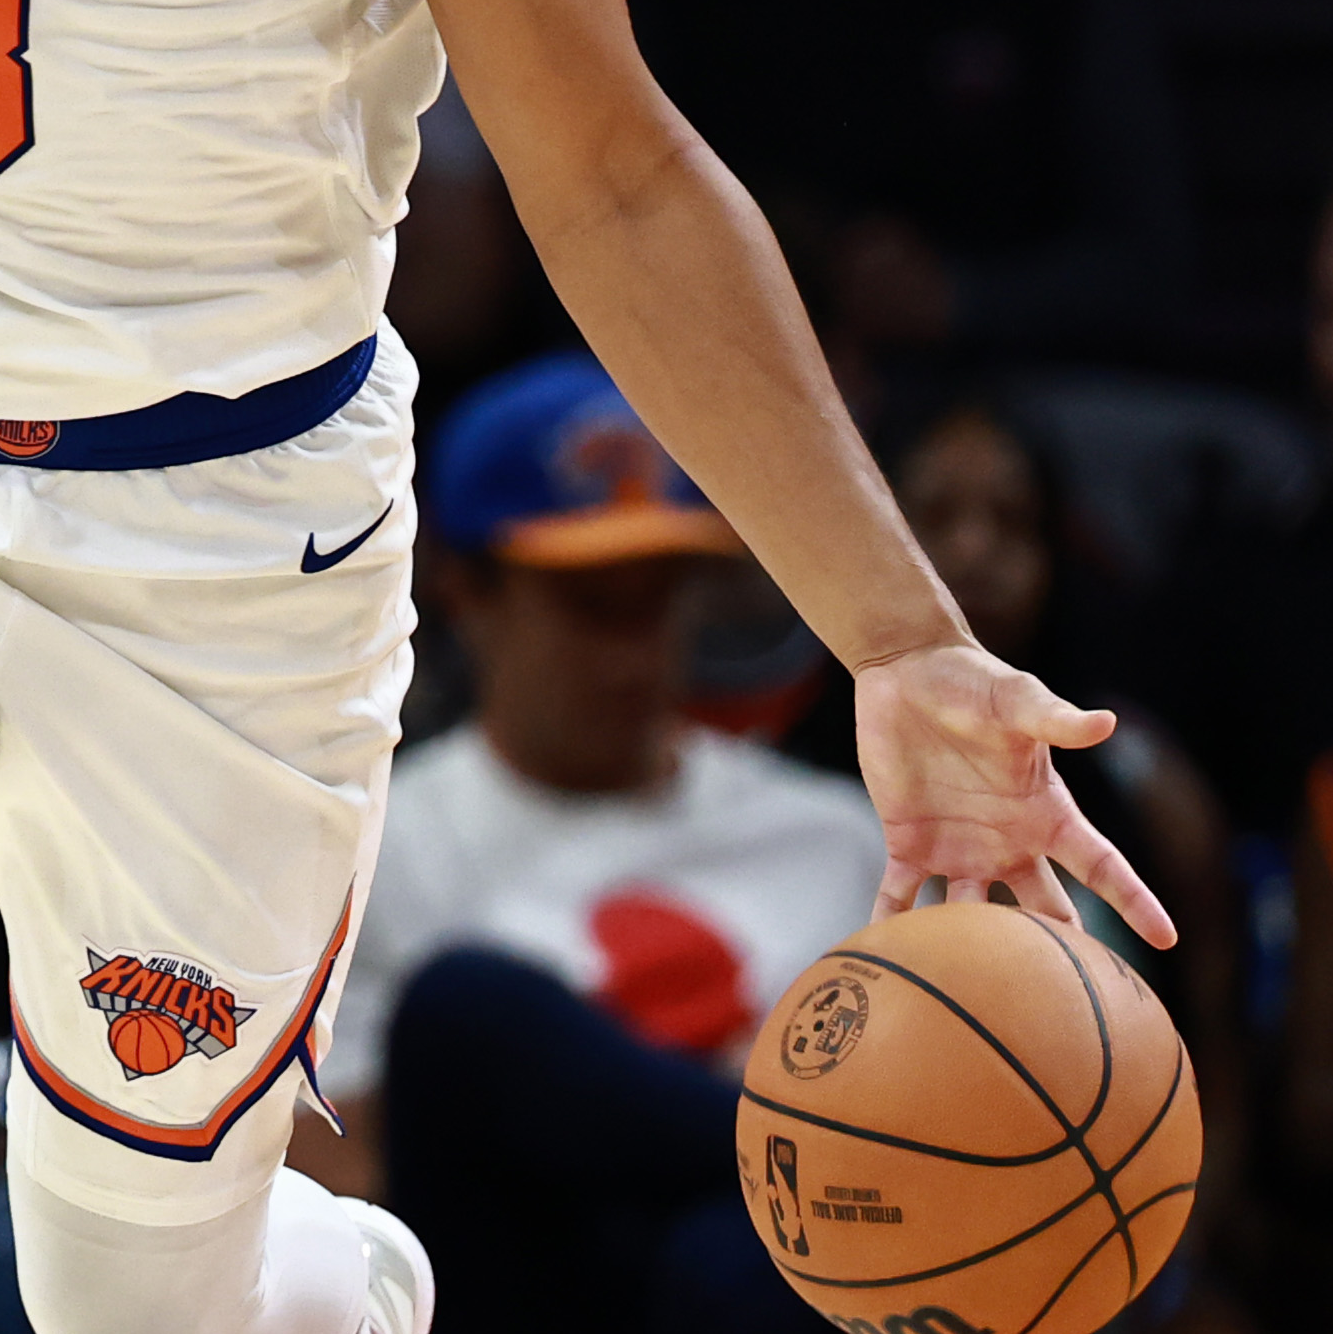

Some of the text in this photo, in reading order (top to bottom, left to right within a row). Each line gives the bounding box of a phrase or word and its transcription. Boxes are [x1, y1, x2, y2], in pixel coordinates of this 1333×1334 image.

[79, 954, 238, 1049] KNICKS
[144, 956, 213, 988] NEW YORK
